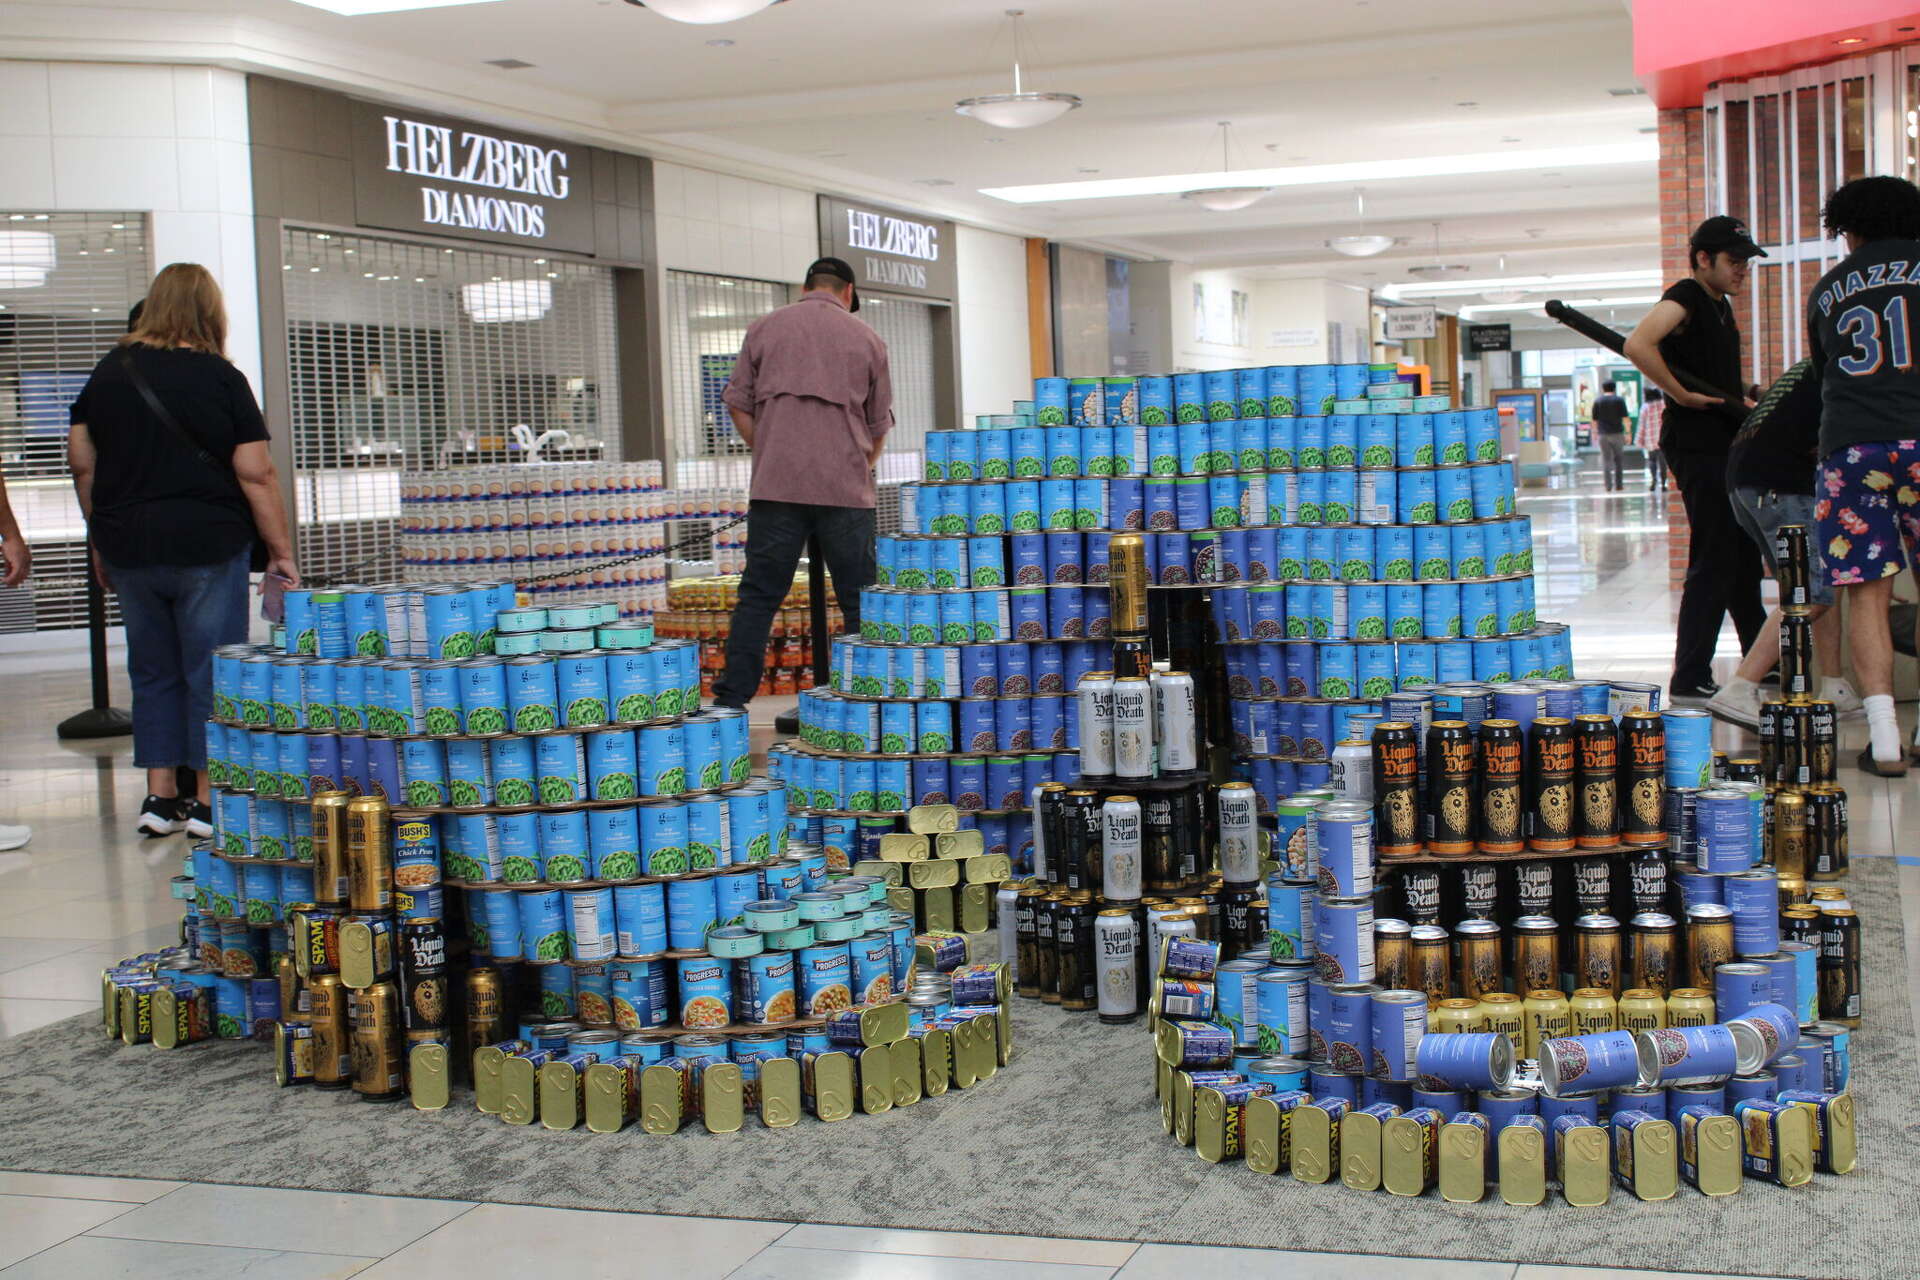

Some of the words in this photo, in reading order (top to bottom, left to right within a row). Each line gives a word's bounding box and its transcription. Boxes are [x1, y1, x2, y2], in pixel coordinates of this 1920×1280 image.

[384, 116, 570, 200] HELZBERG
[421, 187, 545, 238] DIAMONDS
[846, 209, 938, 262] HELZBERG
[865, 262, 927, 290] DIAMONDS
[1836, 296, 1912, 376] 31
[1114, 692, 1144, 708] Liquid
[1117, 706, 1144, 719] Death
[1221, 799, 1249, 815] Liquid
[1108, 814, 1137, 832] Liquid
[1221, 811, 1250, 825] Death
[398, 824, 430, 838] BUSH'S
[1110, 827, 1138, 840] Death
[1462, 867, 1496, 887] Liquid
[1516, 866, 1552, 885] Liquid
[1573, 862, 1609, 882] Liquid
[1630, 861, 1666, 881] Liquid
[1402, 873, 1439, 893] Liquid
[1464, 884, 1497, 901] Death
[1519, 881, 1552, 898] Death
[1576, 879, 1610, 894] Death
[1632, 878, 1666, 894] Death
[1406, 890, 1440, 906] Death
[311, 920, 325, 965] SPAM
[410, 935, 444, 954] Liquid
[1102, 927, 1133, 946] Liquid
[1105, 941, 1133, 954] Death
[413, 952, 445, 967] Death
[686, 968, 721, 982] PROGRESSO
[138, 993, 151, 1035] SPAM
[178, 1001, 188, 1041] SPAM
[1575, 1011, 1612, 1032] Liquid
[1620, 1011, 1657, 1033] Liquid
[1668, 1012, 1705, 1027] Liquid
[1485, 1016, 1521, 1034] Liquid
[1226, 1104, 1239, 1156] SPAM
[1280, 1111, 1292, 1164] SPAM
[1330, 1120, 1340, 1173] SPAM
[1423, 1125, 1431, 1178] SPAM
